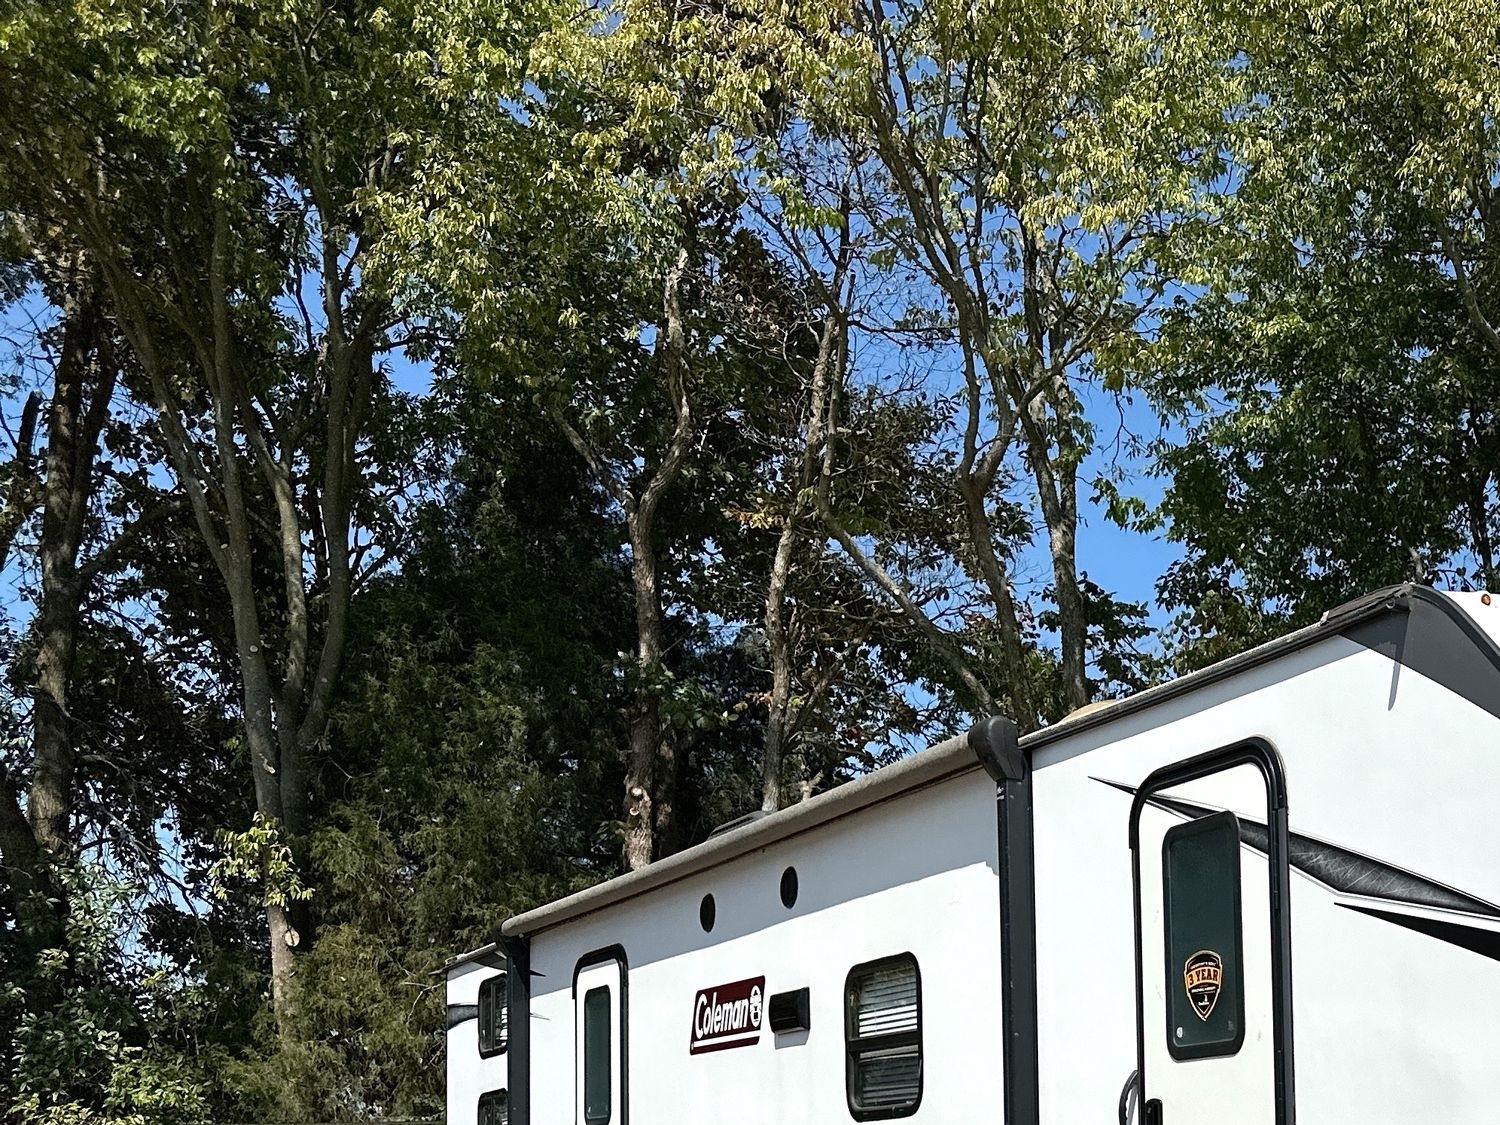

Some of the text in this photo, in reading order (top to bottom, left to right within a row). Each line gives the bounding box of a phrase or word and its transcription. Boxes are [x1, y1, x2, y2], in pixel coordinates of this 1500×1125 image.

[1188, 968, 1219, 986] 3 YEAR
[694, 991, 750, 1040] Coleman
